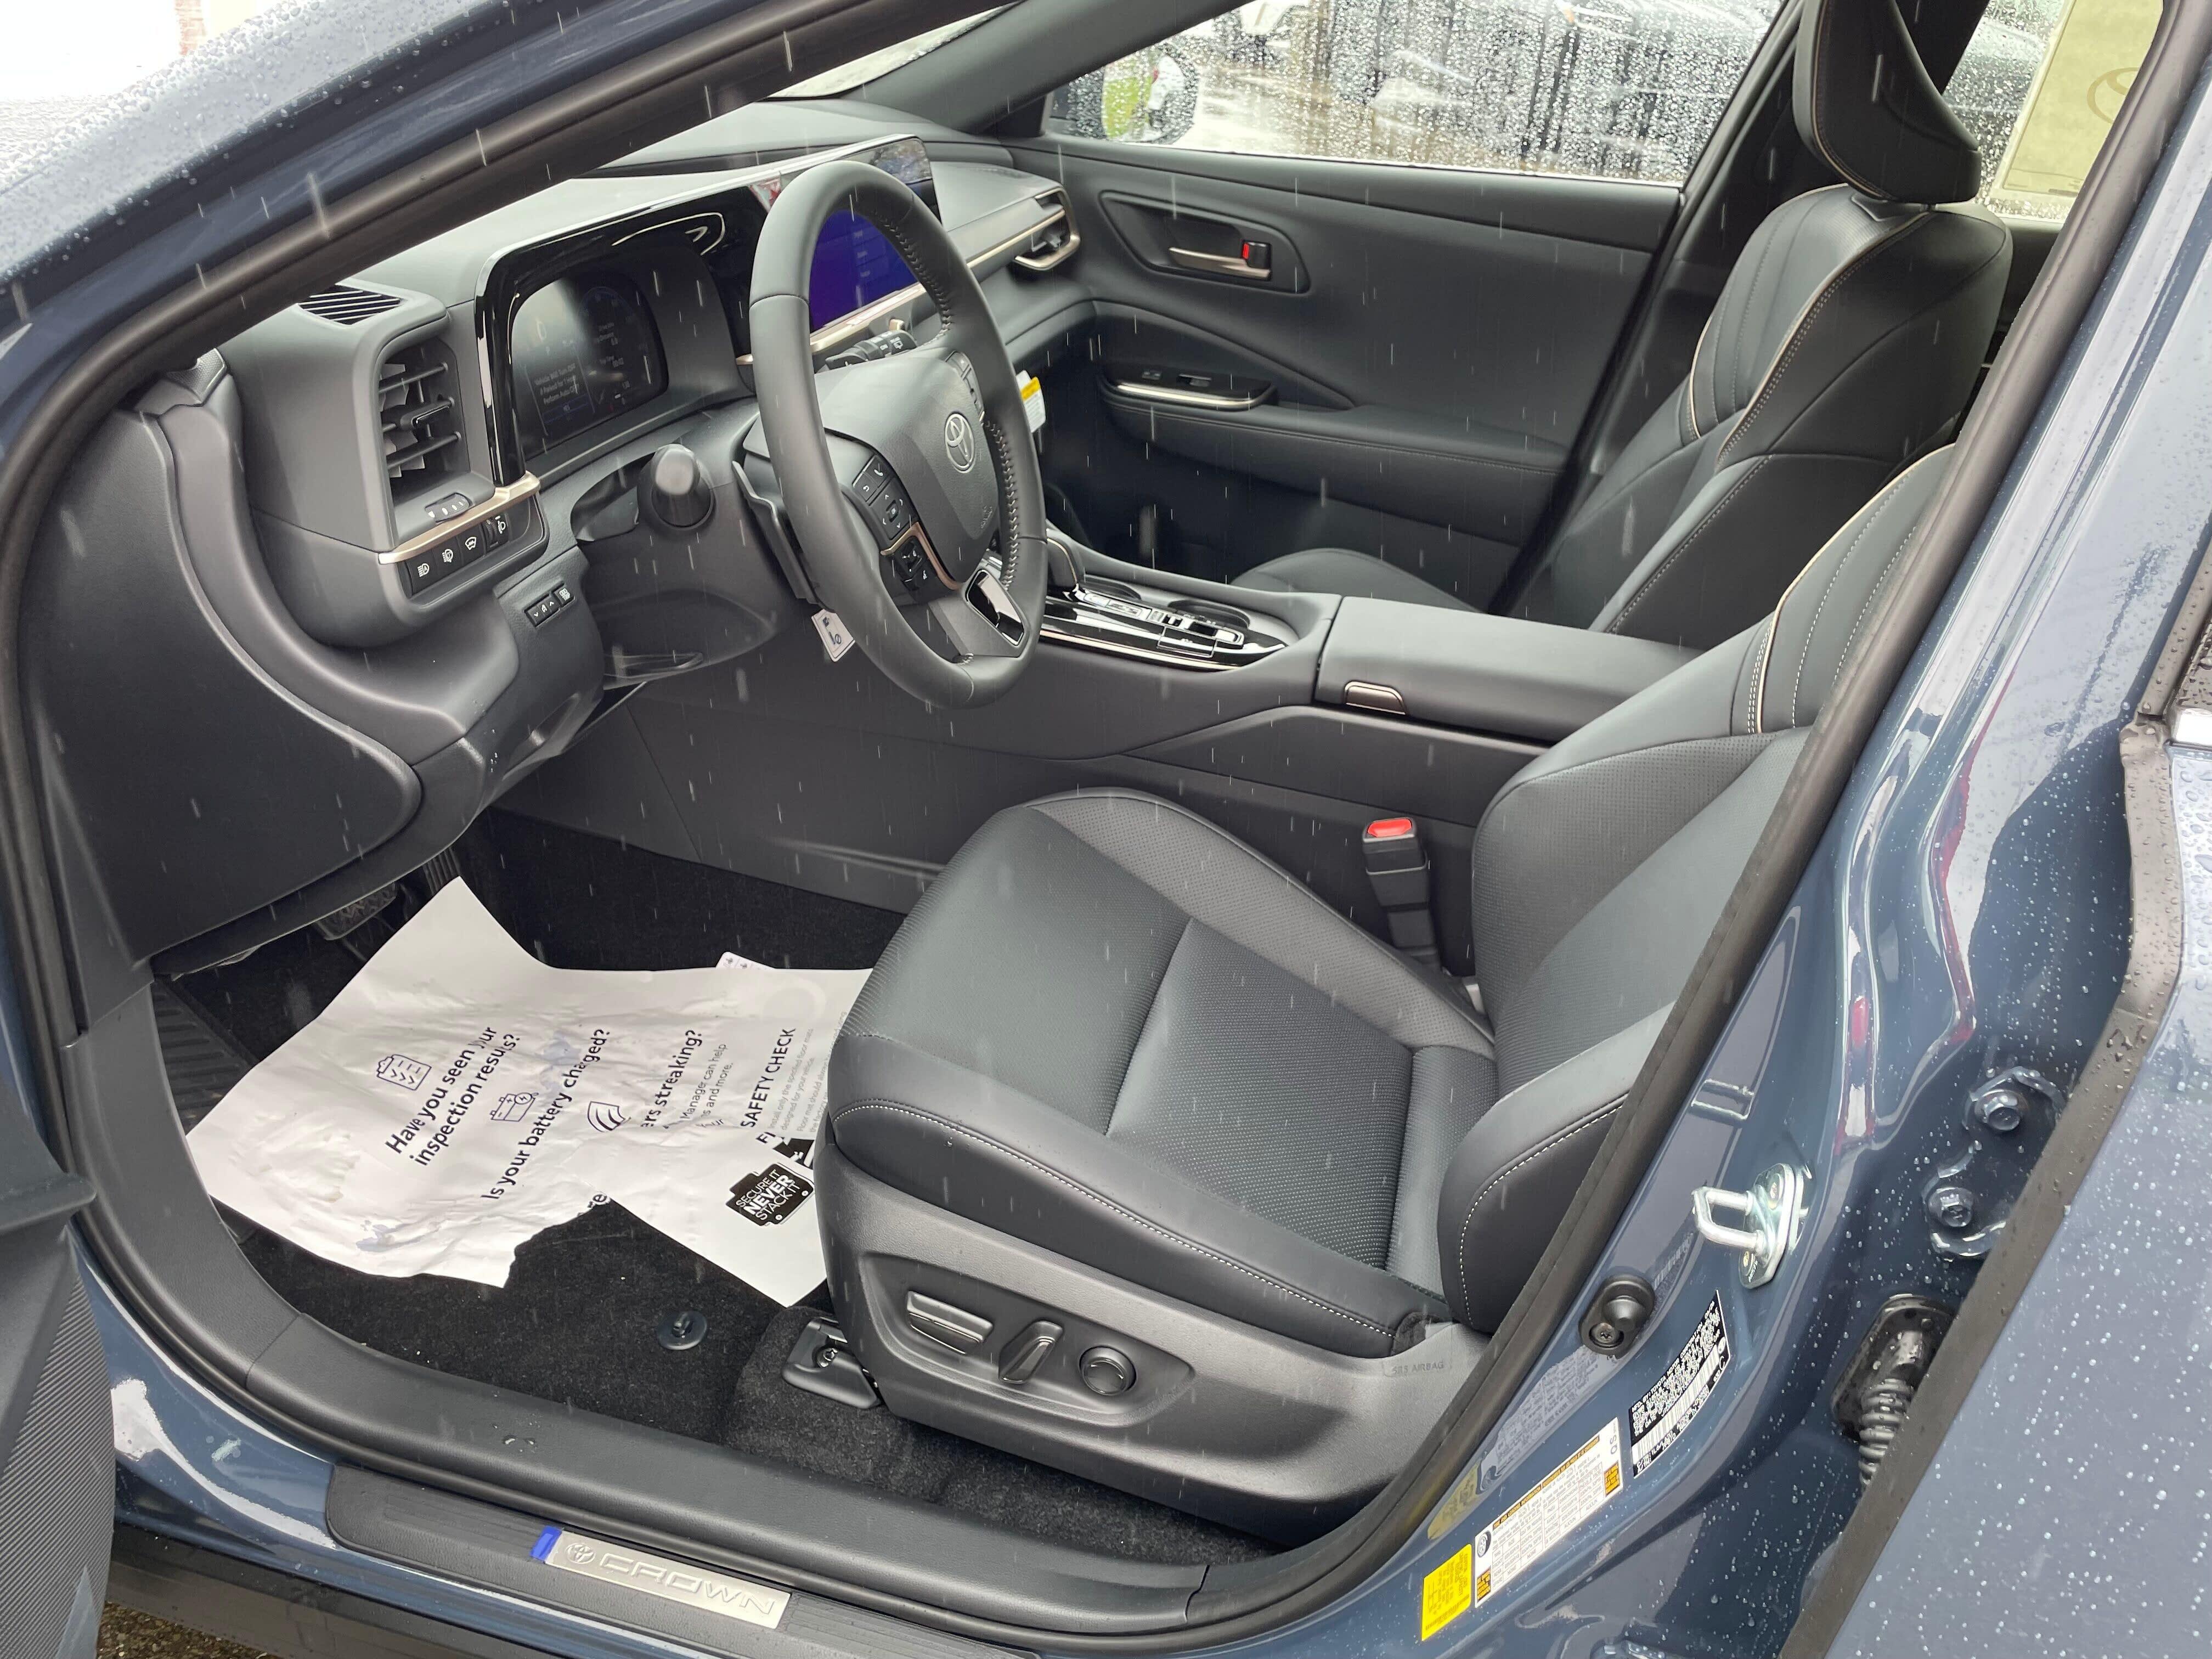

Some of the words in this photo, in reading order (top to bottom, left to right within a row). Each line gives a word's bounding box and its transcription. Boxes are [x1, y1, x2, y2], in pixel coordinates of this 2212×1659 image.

[654, 1030, 702, 1107] streaking?
[704, 1064, 716, 1080] can
[708, 1043, 728, 1062] help
[385, 1118, 426, 1154] Have
[417, 1087, 448, 1121] you
[442, 1049, 476, 1085] seen
[468, 1026, 496, 1049] yur
[707, 1088, 720, 1108] and
[715, 1063, 733, 1087] more.
[740, 1076, 774, 1127] SAFETY
[765, 1028, 796, 1073] CHECK
[782, 1084, 792, 1096] the
[798, 1076, 807, 1092] your
[778, 1090, 789, 1108] only
[409, 1084, 482, 1166] inspection
[481, 1187, 505, 1199] Is
[497, 1150, 531, 1185] your
[518, 1092, 572, 1146] battery
[736, 1177, 773, 1207] SECURE
[769, 1169, 780, 1180] IT
[743, 1175, 793, 1215] NEVER
[755, 1190, 793, 1220] STACK
[787, 1180, 800, 1193] IT
[1650, 1375, 1666, 1393] TOYOTA
[600, 1553, 776, 1615] CROWN
